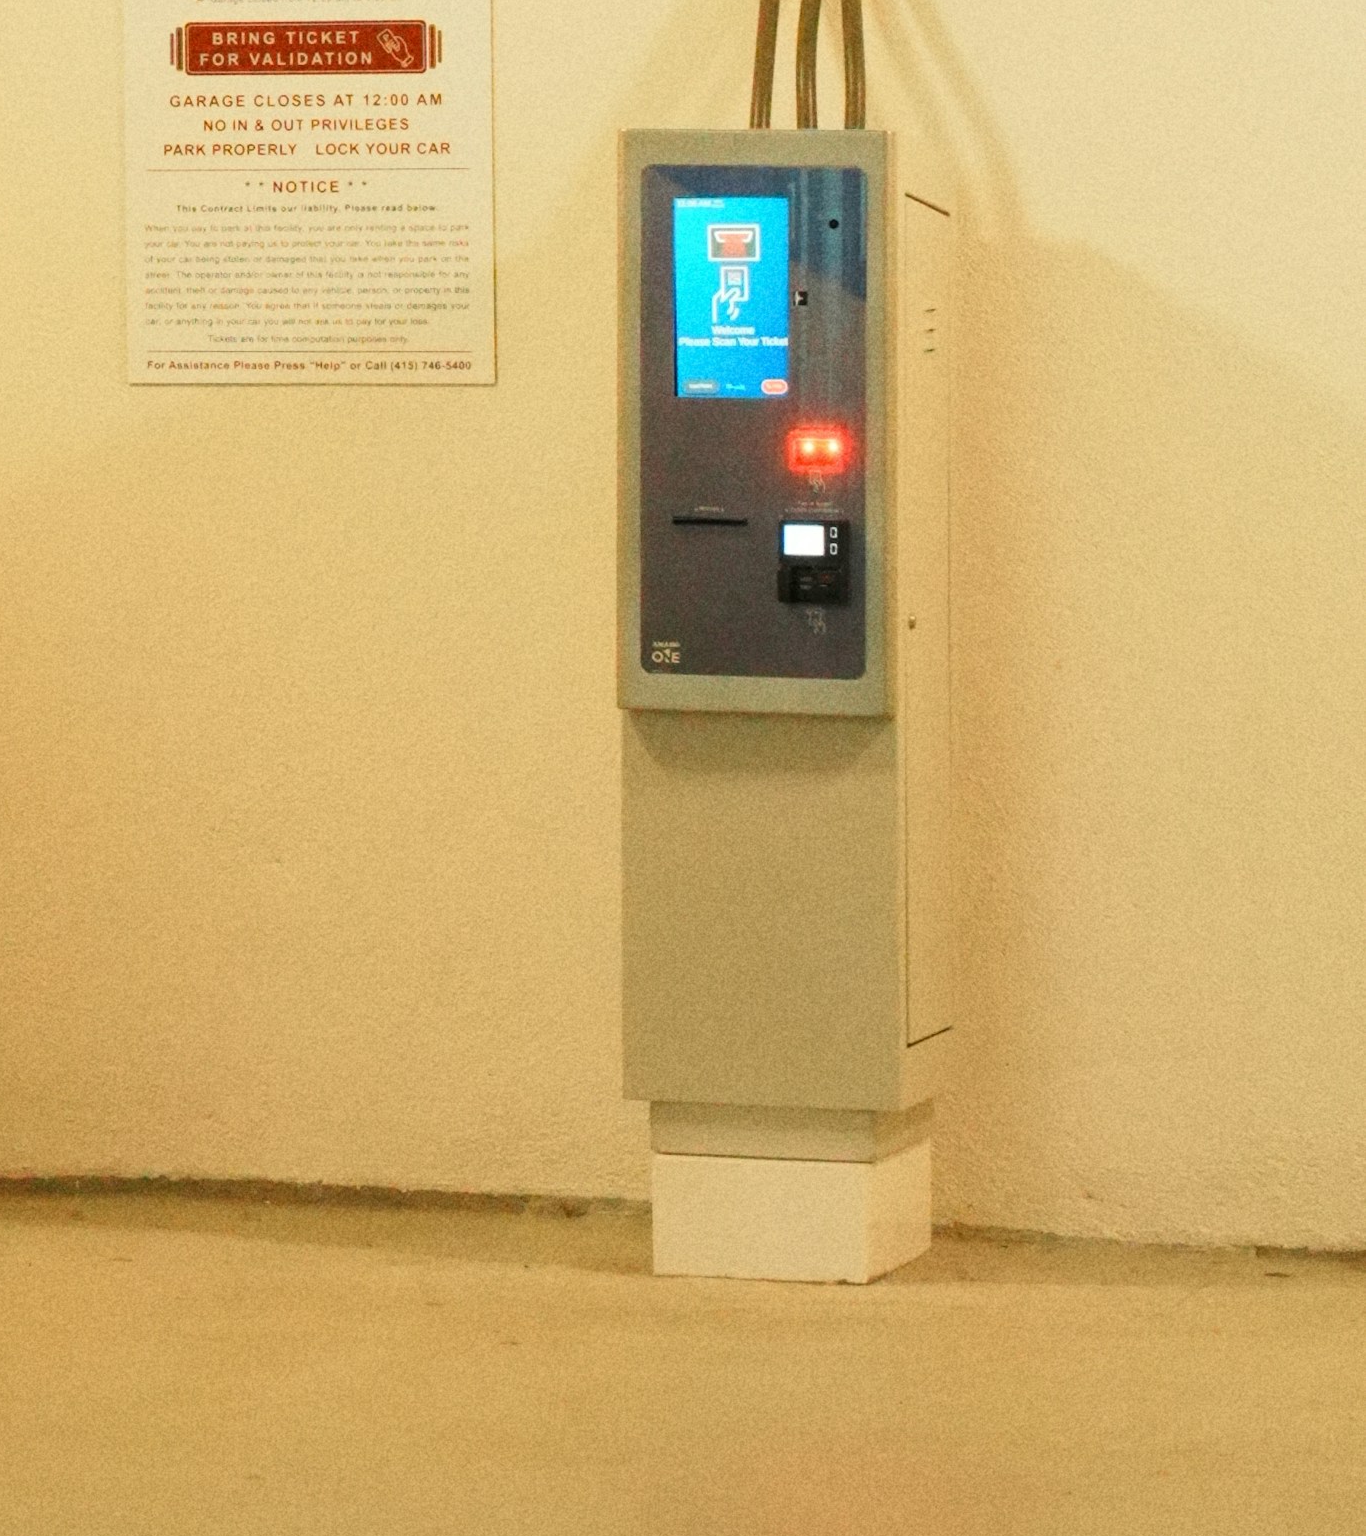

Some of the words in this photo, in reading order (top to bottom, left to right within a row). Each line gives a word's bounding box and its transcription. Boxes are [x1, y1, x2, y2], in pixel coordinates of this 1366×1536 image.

[212, 32, 276, 45] BRING
[286, 31, 359, 44] TICKET
[200, 53, 239, 66] FOR
[249, 52, 372, 65] VALIDATION
[170, 95, 245, 107] GARAGE
[254, 94, 325, 106] CLOSES
[334, 94, 354, 106] AT
[364, 94, 409, 106] 12:00
[417, 94, 442, 105] AM
[204, 119, 226, 131] NO
[233, 119, 247, 131] IN
[255, 119, 264, 131] &
[272, 119, 303, 131] OUT
[311, 118, 409, 130] PRIVILEGES
[164, 144, 205, 156] PARK
[212, 144, 296, 155] PROPERLY
[316, 143, 359, 155] LOCK
[366, 143, 410, 154] YOUR
[417, 142, 450, 154] CAR
[273, 181, 339, 193] NOTICE
[247, 204, 277, 212] Limits
[344, 204, 377, 212] Please
[711, 326, 755, 335] Welcome
[678, 337, 710, 347] Please
[712, 337, 736, 347] Scan
[738, 337, 759, 346] Your
[147, 360, 166, 370] For
[168, 360, 230, 370] Assistance
[233, 360, 270, 370] Please
[273, 360, 305, 370] Press
[349, 362, 361, 370] or
[365, 360, 387, 370] Call
[390, 360, 418, 372] (415)
[421, 360, 472, 370] 746-5400
